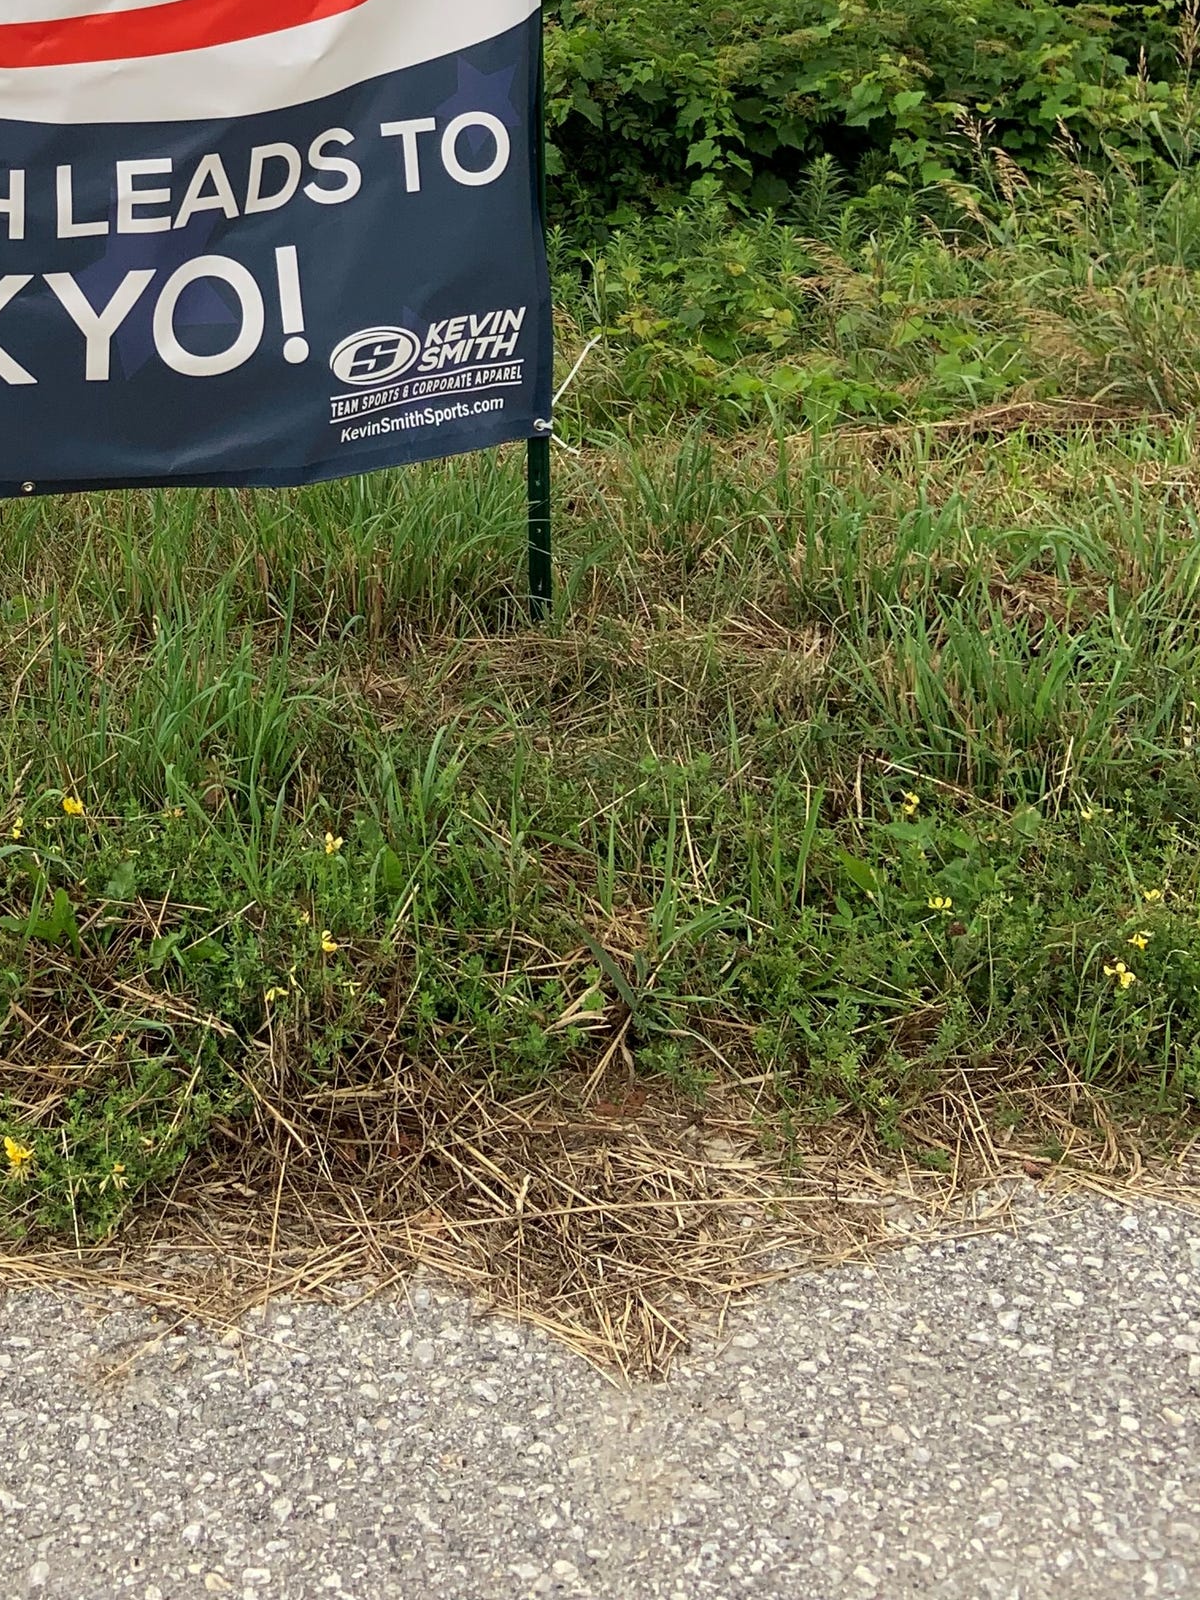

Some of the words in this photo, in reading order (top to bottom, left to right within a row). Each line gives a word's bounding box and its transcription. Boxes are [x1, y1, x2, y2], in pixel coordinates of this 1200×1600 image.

[56, 127, 362, 238] LEADS
[380, 111, 510, 193] TO
[424, 306, 526, 348] KEVIN
[417, 332, 519, 372] SMITH
[331, 397, 359, 418] TEAM
[362, 387, 400, 410] SPORTS
[412, 374, 472, 395] CORPORATE
[475, 365, 522, 385] APPAREL
[340, 398, 504, 443] KevinSmithSports.com
